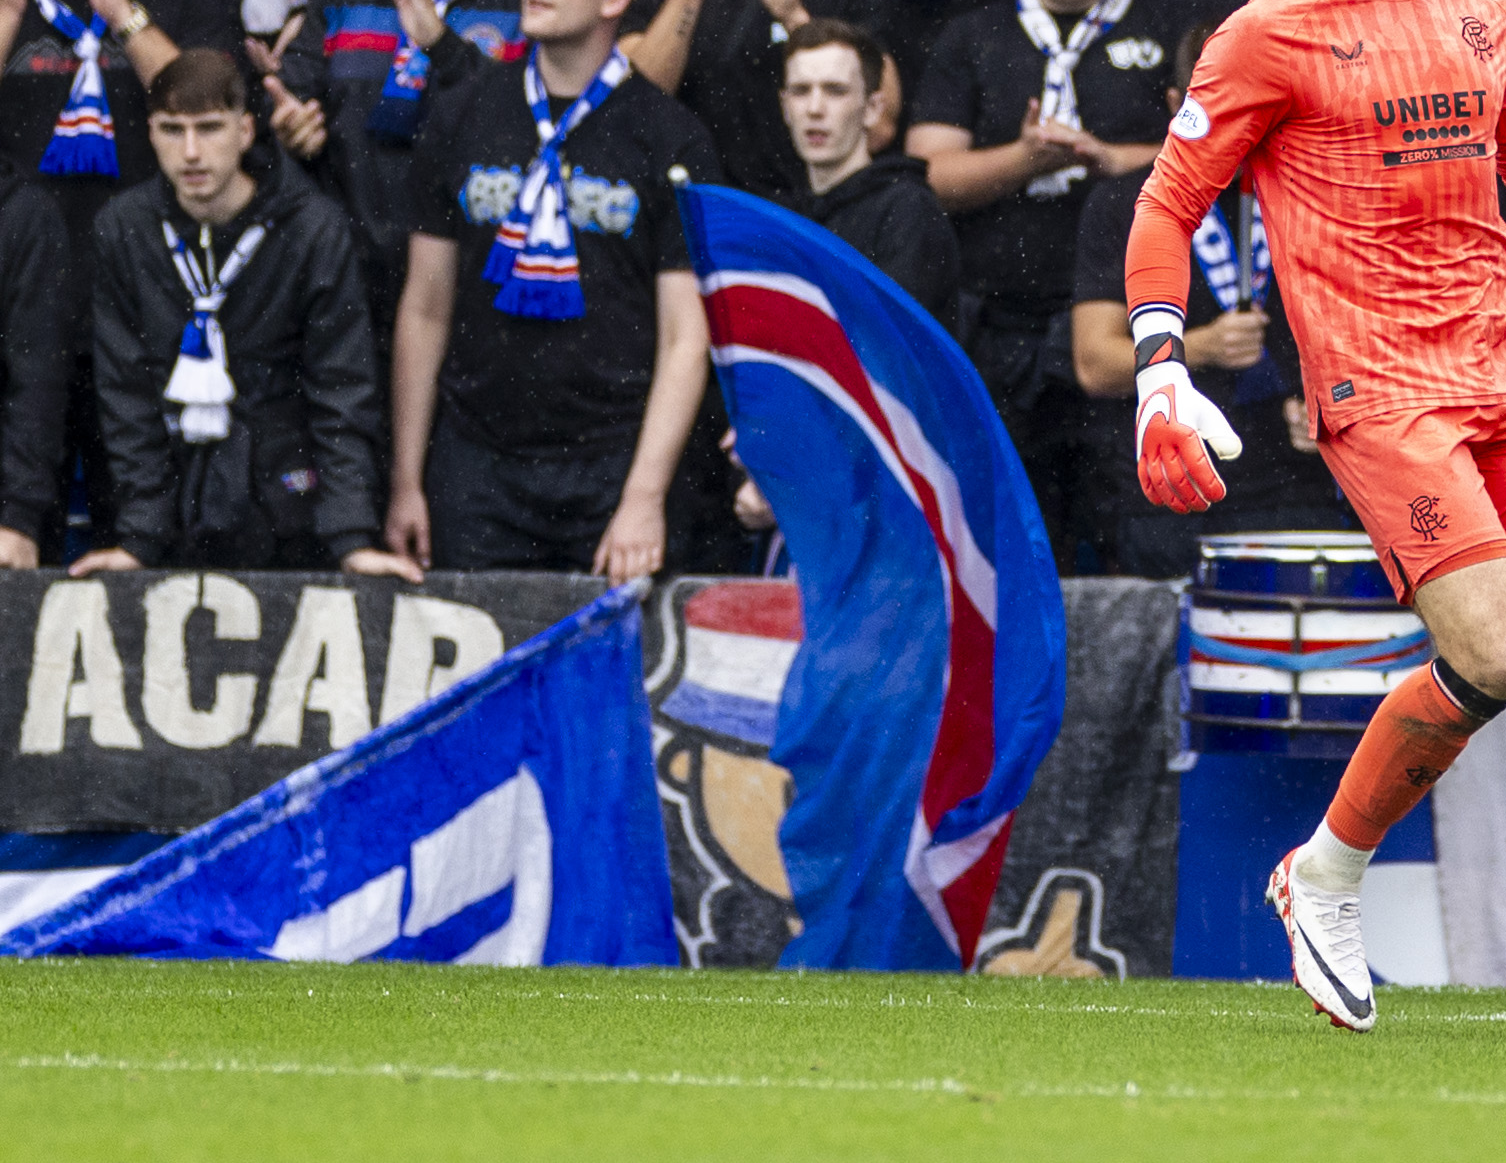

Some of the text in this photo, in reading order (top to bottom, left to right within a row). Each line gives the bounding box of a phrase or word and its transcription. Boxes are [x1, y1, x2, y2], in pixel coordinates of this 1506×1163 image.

[1372, 90, 1487, 127] UNIBET
[1399, 144, 1479, 165] ZERO% MISSION
